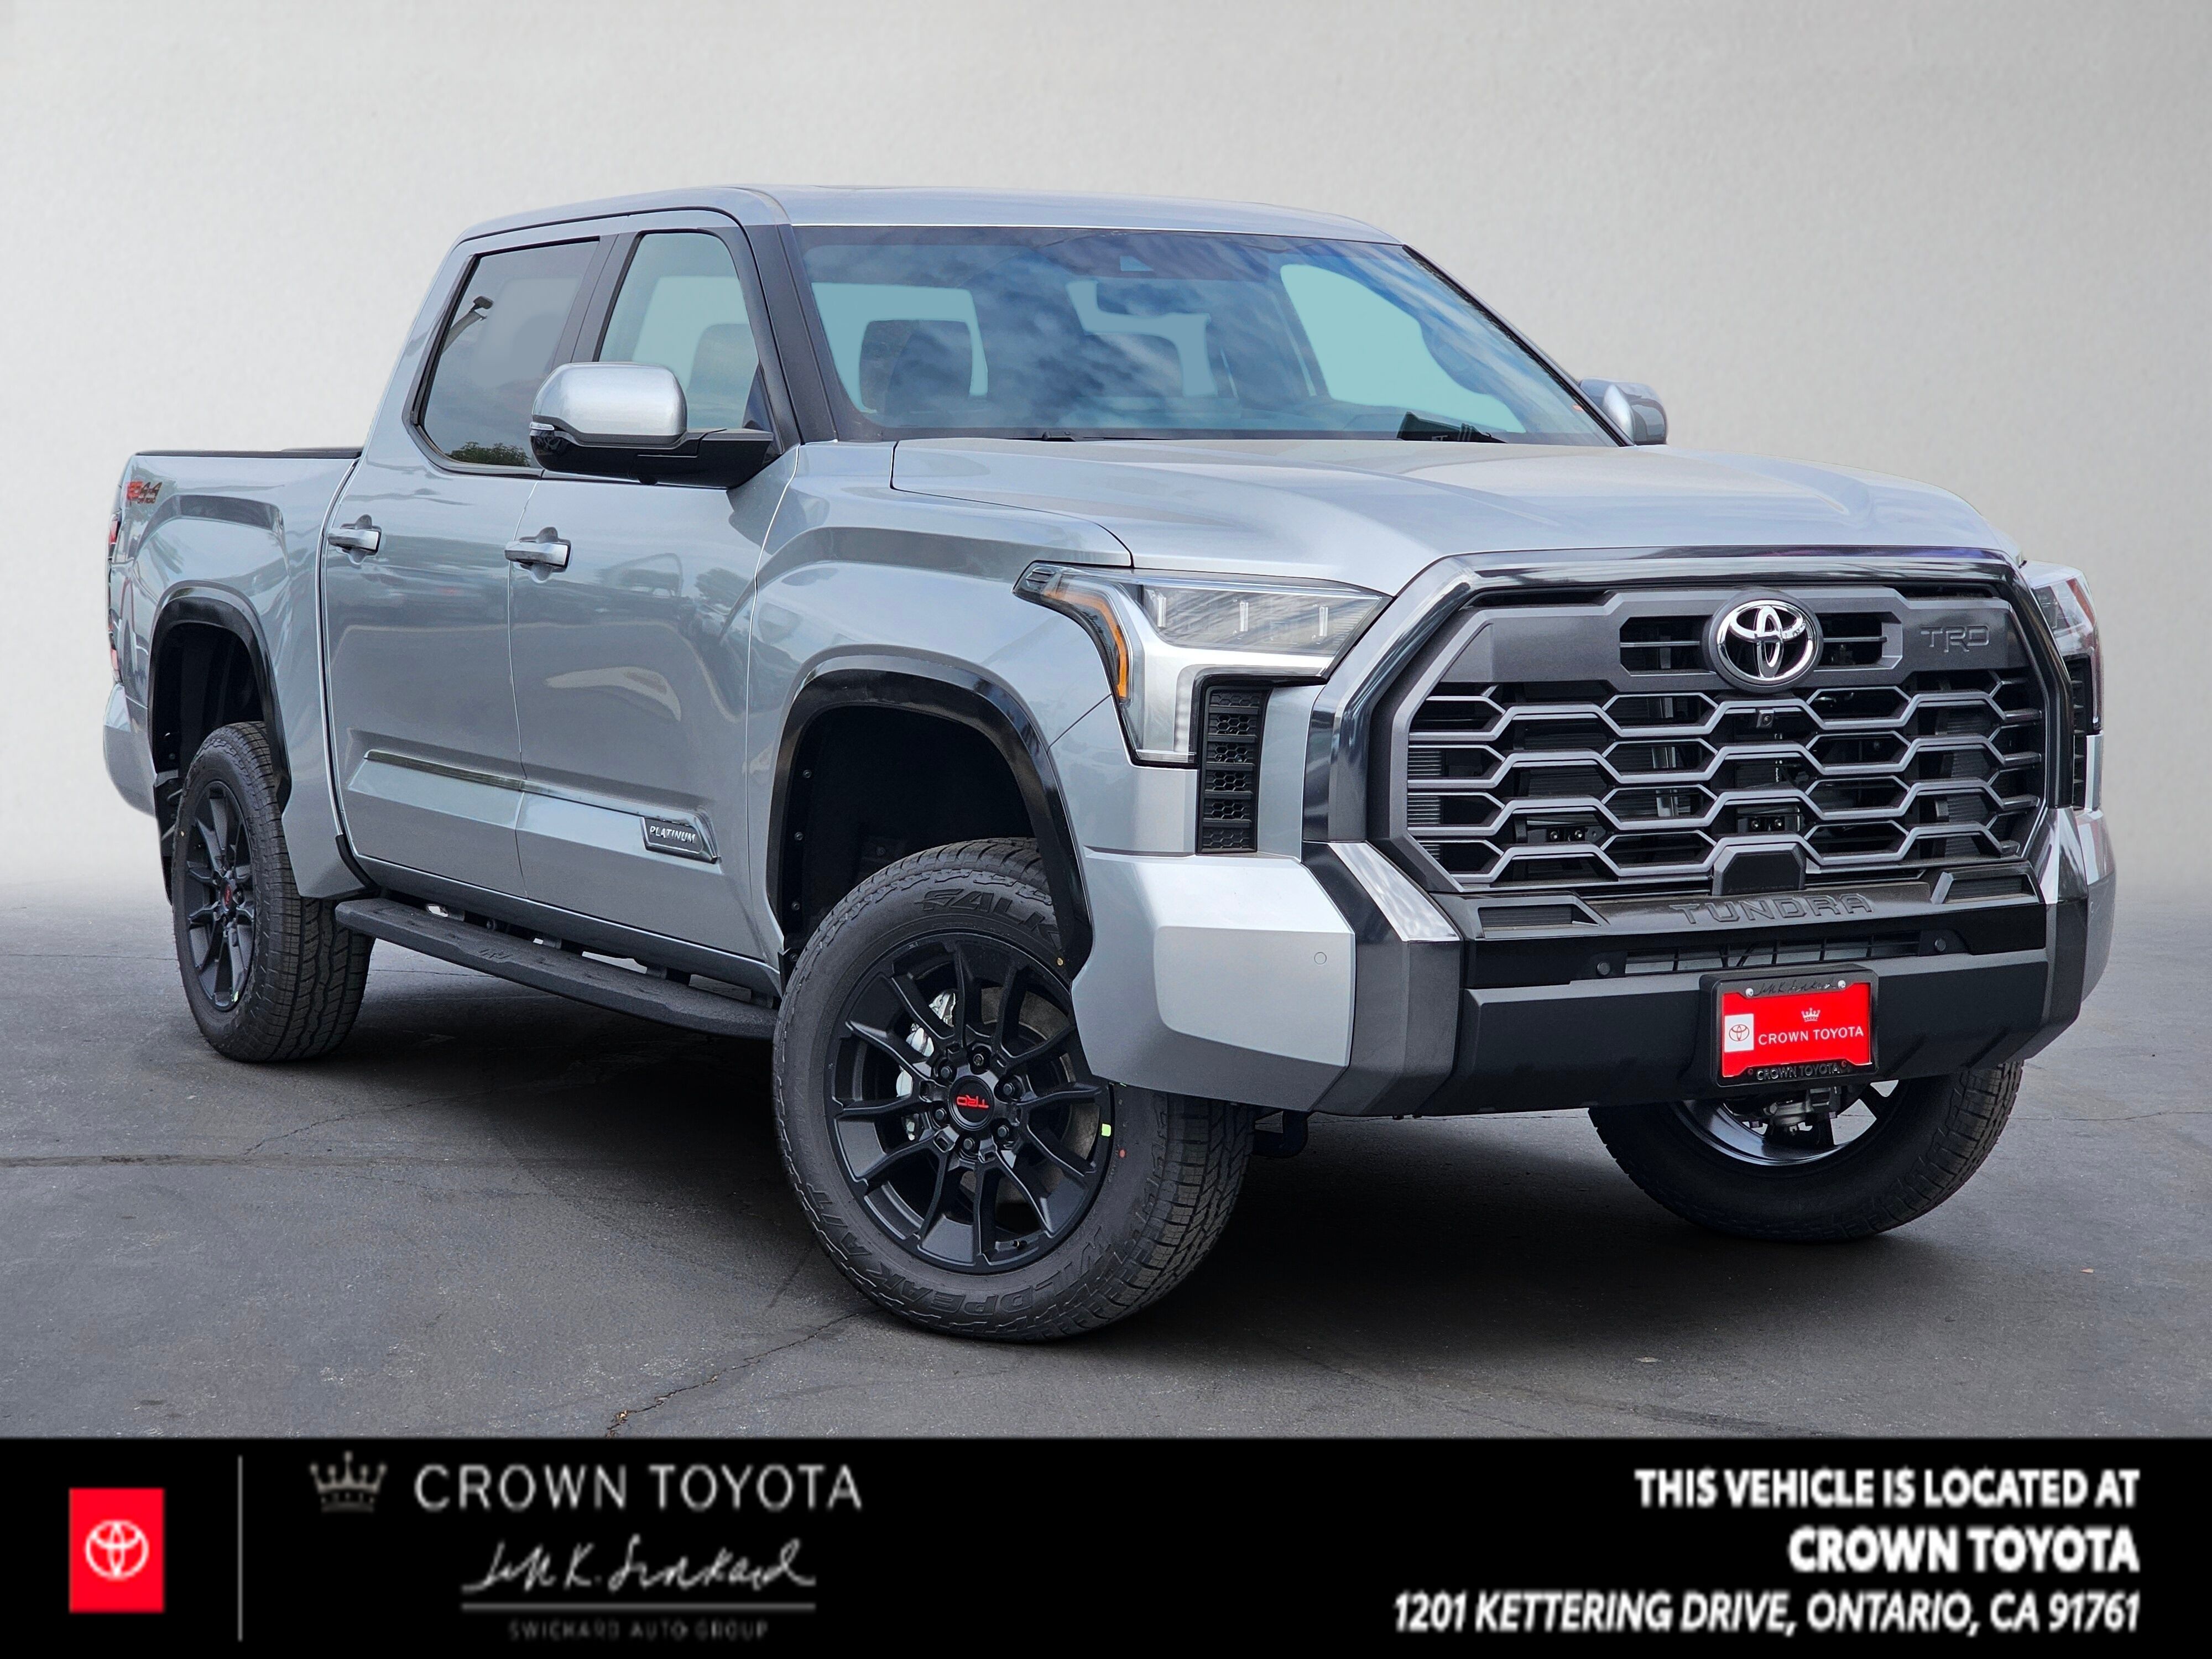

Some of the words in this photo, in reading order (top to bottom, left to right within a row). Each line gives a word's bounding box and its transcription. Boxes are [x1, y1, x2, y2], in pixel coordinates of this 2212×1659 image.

[1919, 624, 1991, 654] TRD
[650, 825, 696, 843] PLATINUM
[1669, 893, 1872, 925] TUNDRA
[1758, 1031, 1809, 1046] CROWN
[1813, 1026, 1864, 1041] TOYOTA
[1756, 1066, 1797, 1081] CROWN
[1799, 1062, 1841, 1077] TOYOTA
[956, 1094, 989, 1109] TRD
